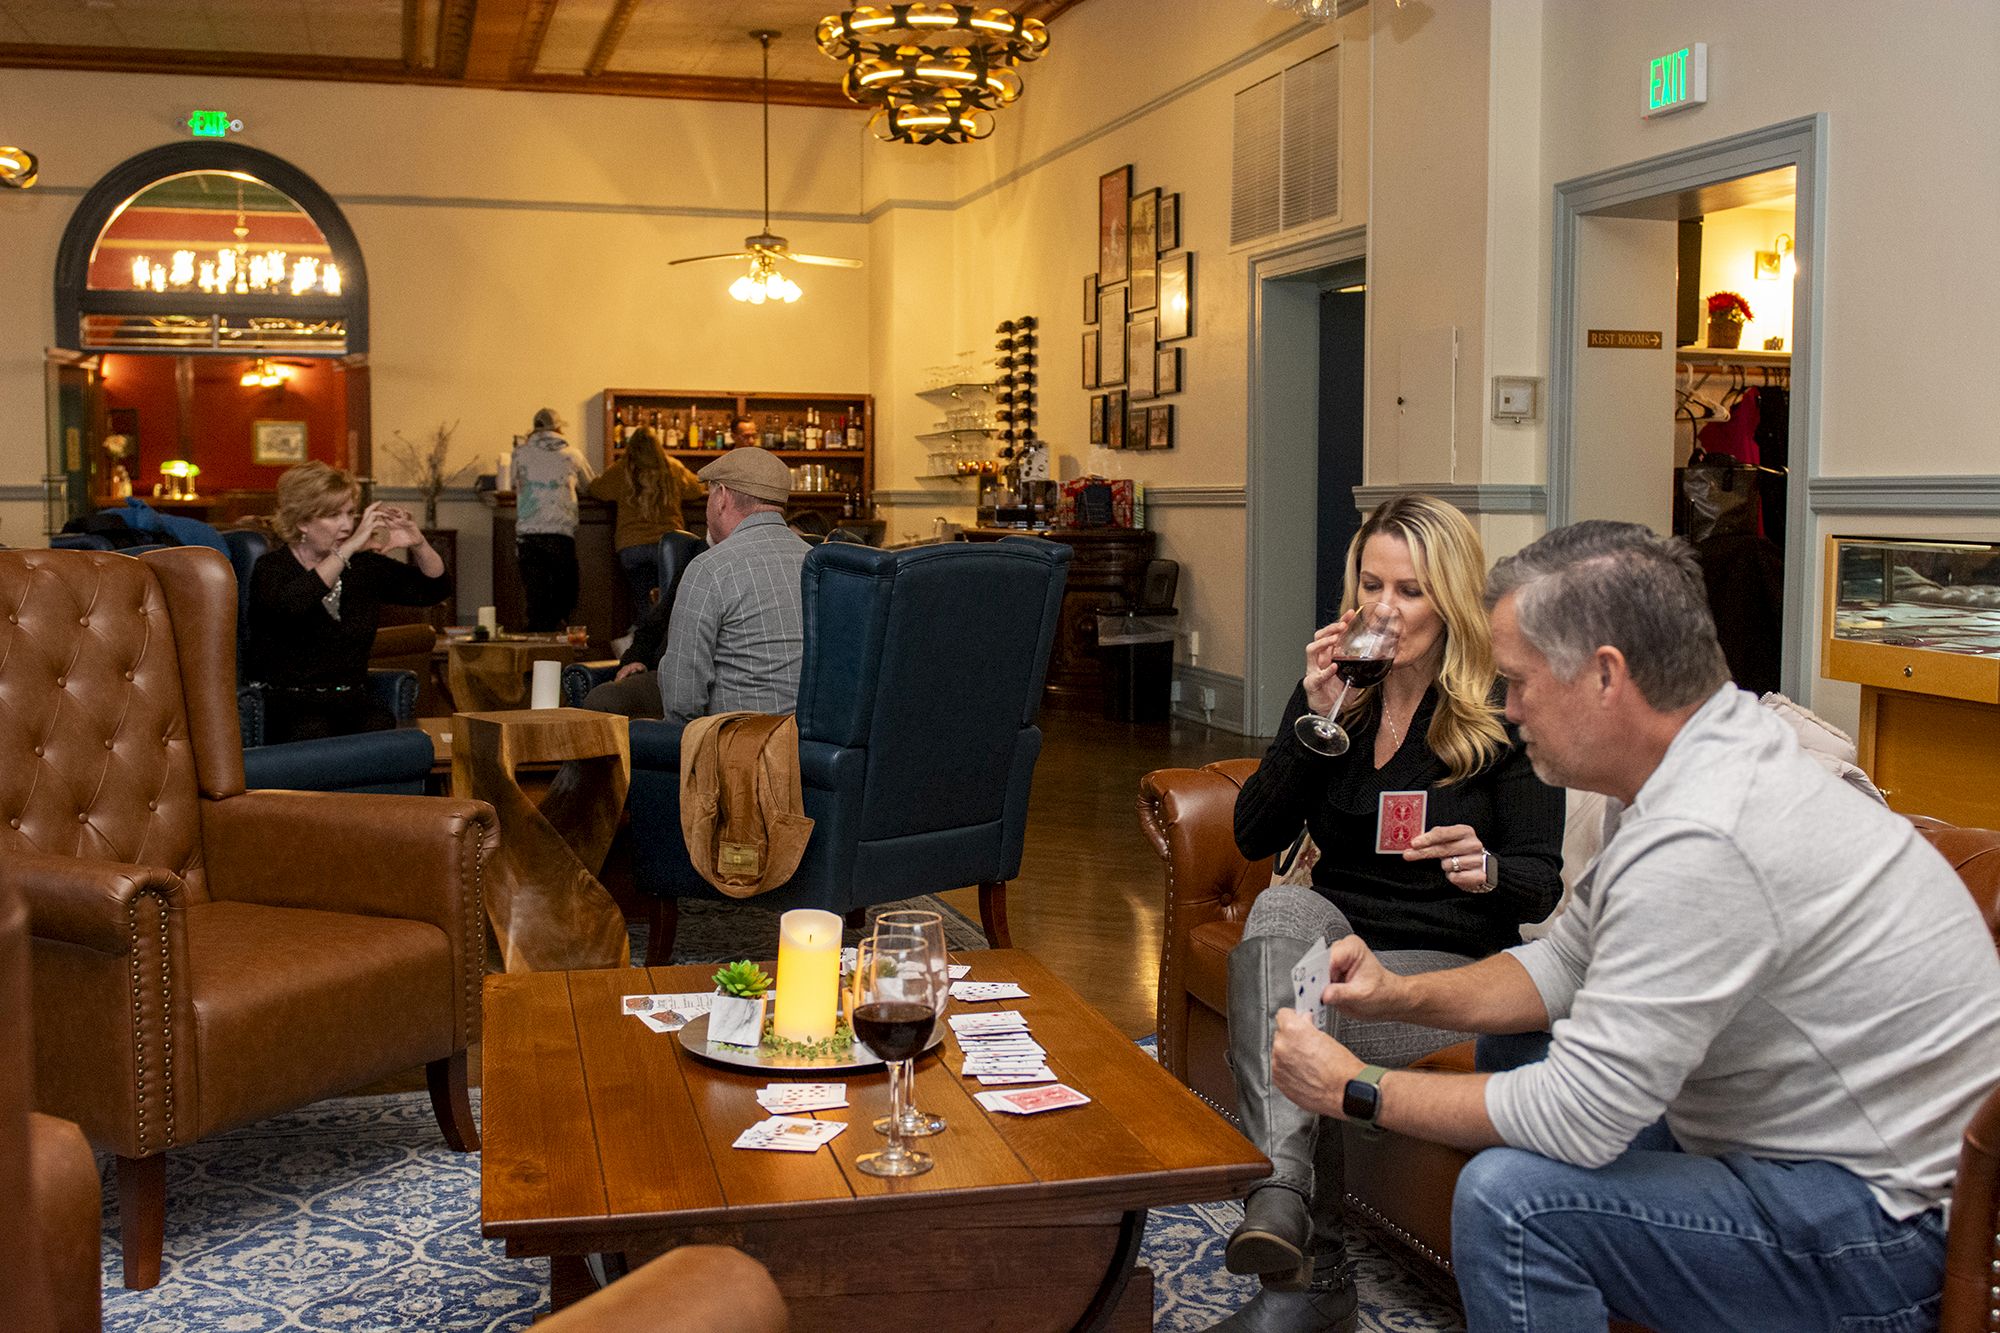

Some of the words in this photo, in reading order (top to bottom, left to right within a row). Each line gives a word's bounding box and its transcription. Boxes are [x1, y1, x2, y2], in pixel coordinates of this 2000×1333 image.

[1650, 48, 1688, 109] EXIT
[193, 111, 226, 137] EXIT
[1591, 333, 1615, 345] REST
[1618, 334, 1649, 345] ROOMS
